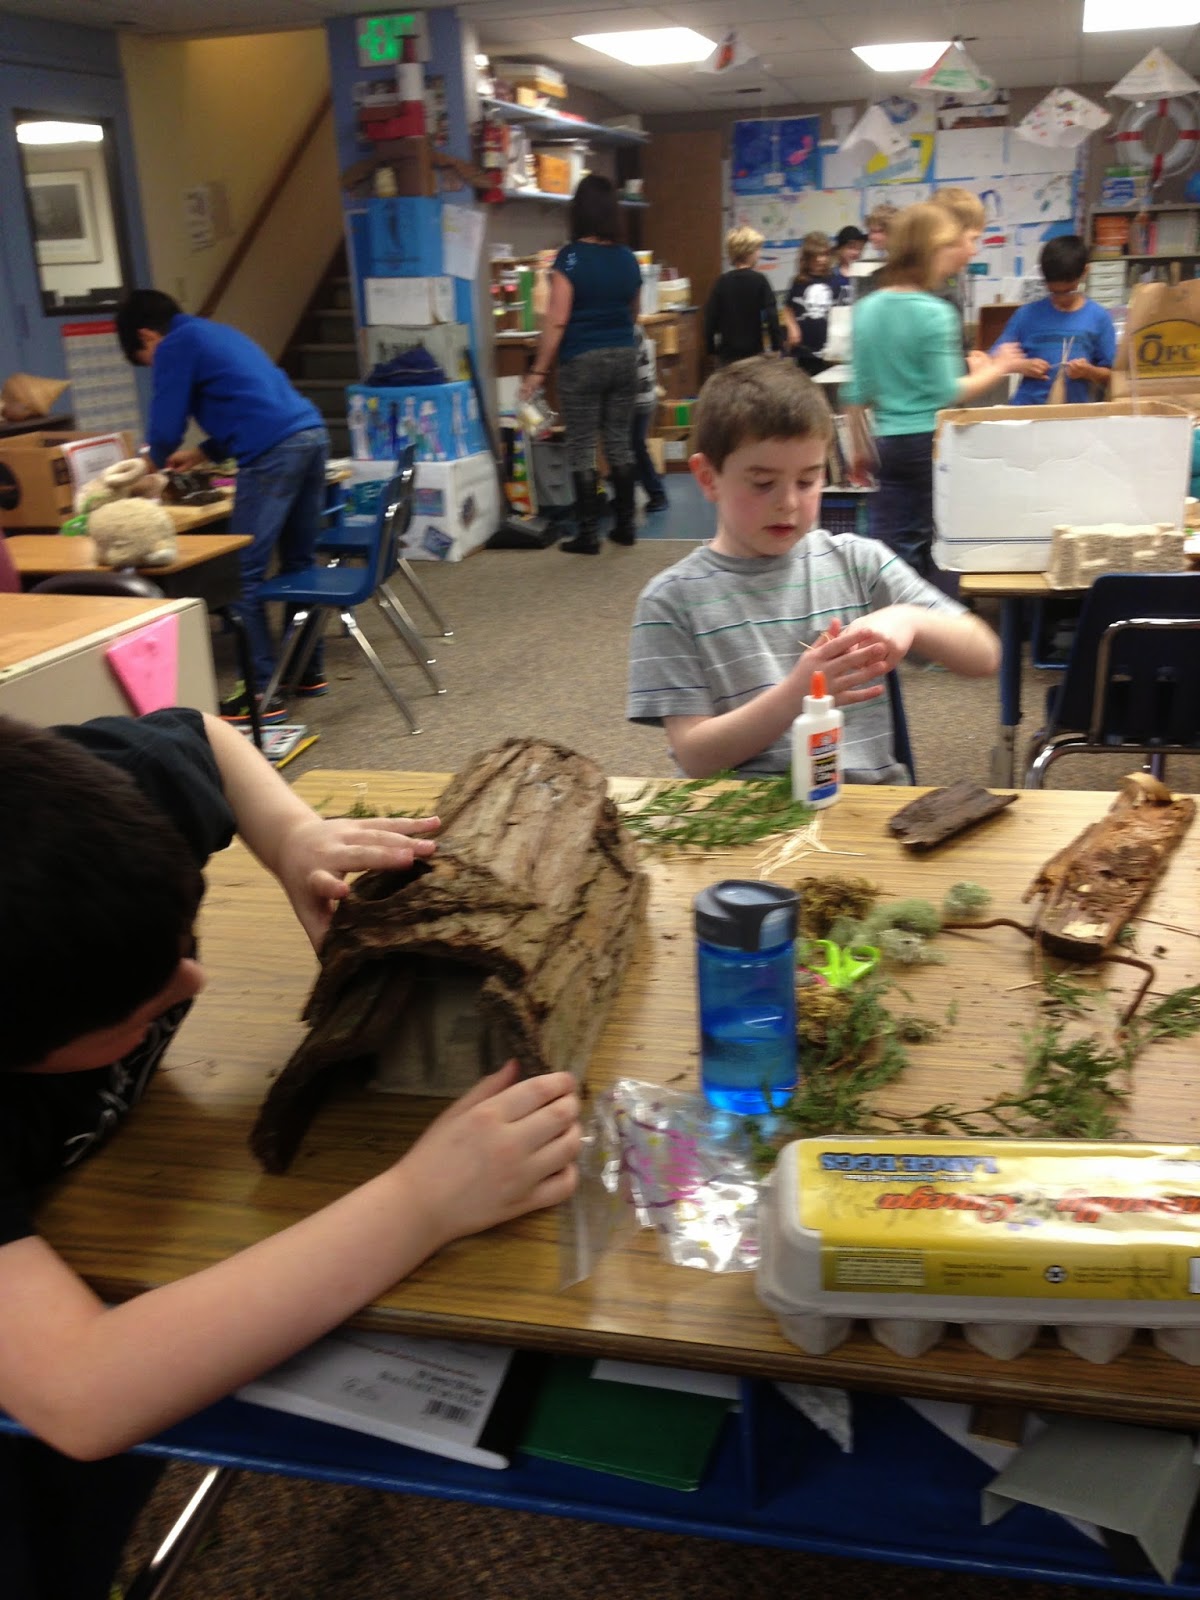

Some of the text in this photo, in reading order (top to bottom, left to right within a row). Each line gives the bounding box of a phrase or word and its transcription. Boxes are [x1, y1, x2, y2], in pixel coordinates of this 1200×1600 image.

[1138, 339, 1198, 366] QFC
[820, 1152, 998, 1173] LARGE EGGS
[876, 1185, 1017, 1224] Omega
